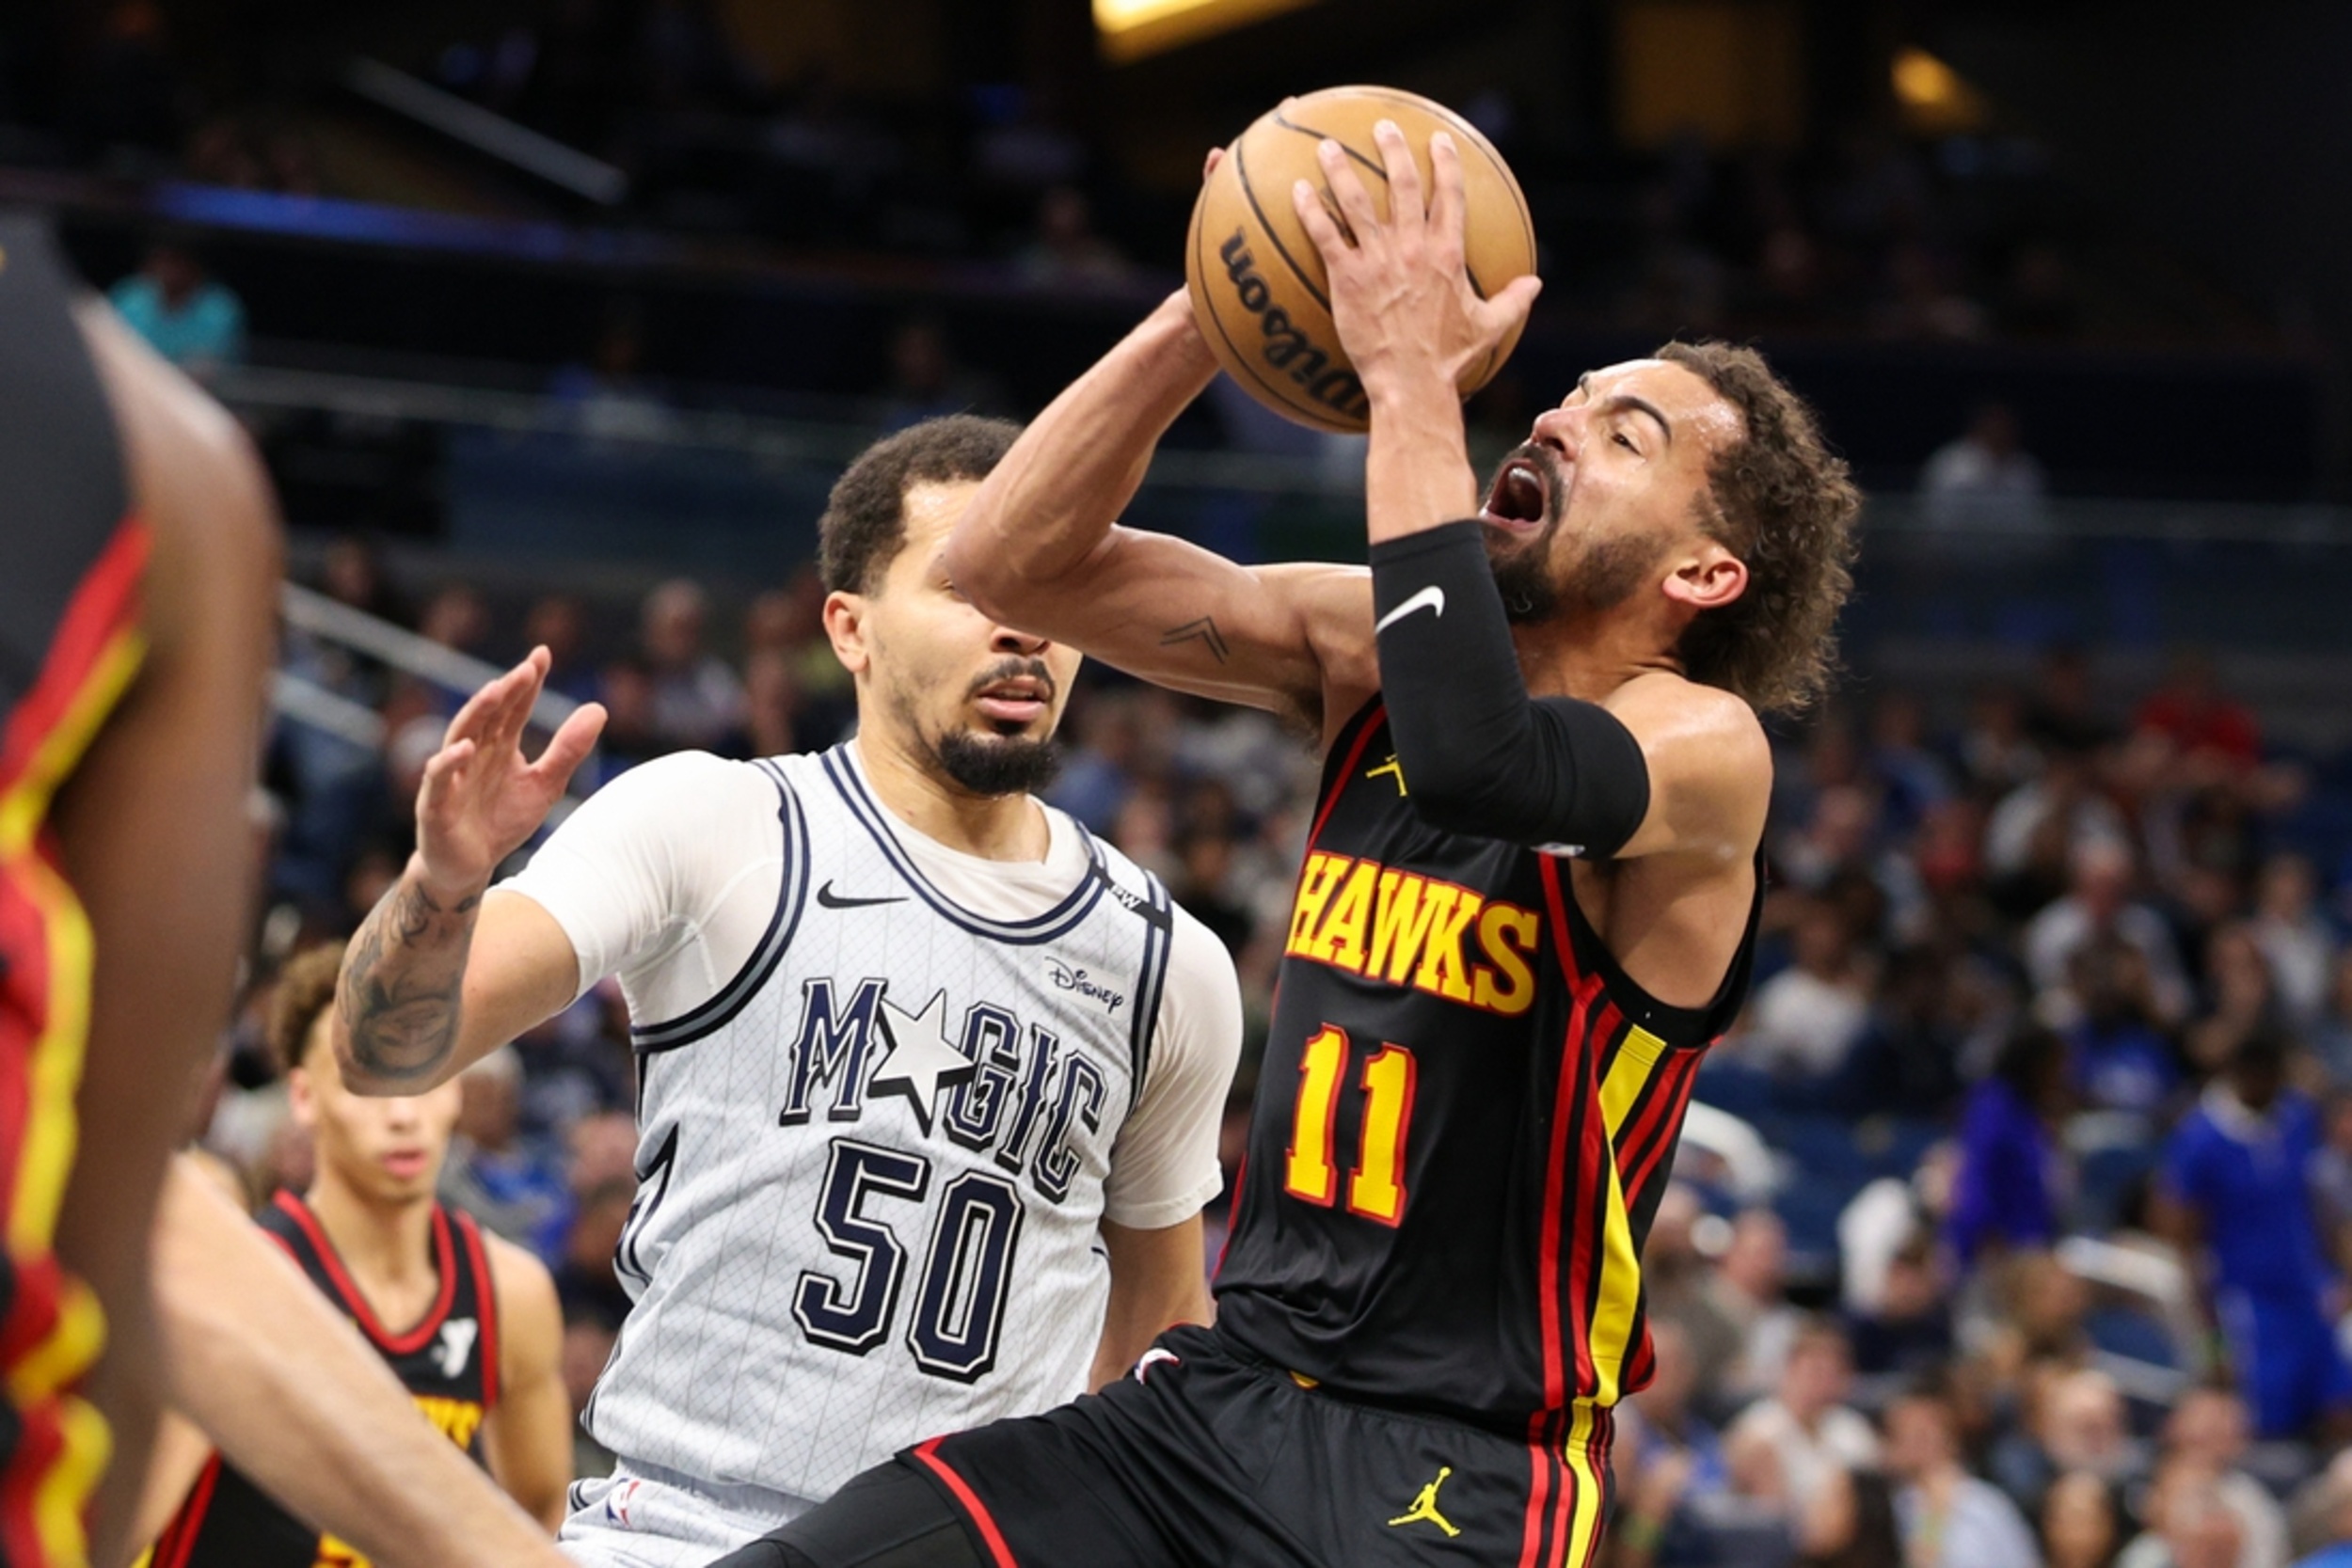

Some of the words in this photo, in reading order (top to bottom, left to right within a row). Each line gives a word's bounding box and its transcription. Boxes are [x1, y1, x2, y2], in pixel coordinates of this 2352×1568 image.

[1283, 851, 1540, 1019] HAWKS
[1284, 1022, 1417, 1228] 11
[791, 1136, 1025, 1386] 50
